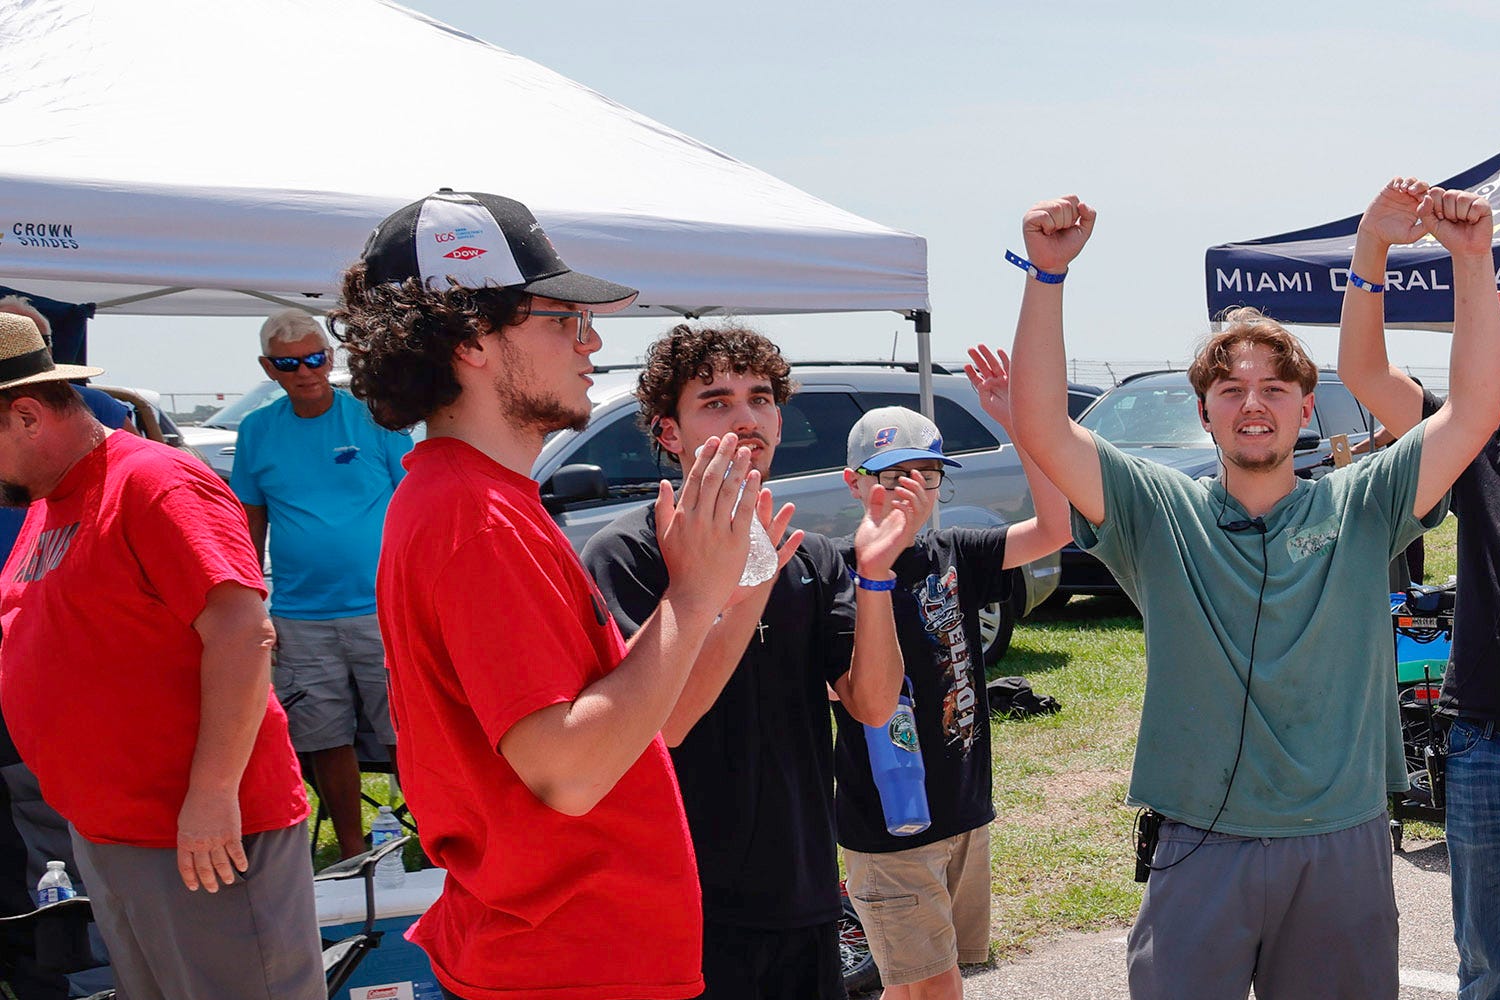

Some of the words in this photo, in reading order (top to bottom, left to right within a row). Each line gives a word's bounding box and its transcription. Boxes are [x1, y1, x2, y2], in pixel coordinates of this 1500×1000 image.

[13, 222, 73, 238] CROWN
[17, 236, 79, 250] SHADES
[1216, 268, 1312, 292] MIAMI
[1328, 268, 1449, 291] CRAL
[874, 426, 899, 449] 9
